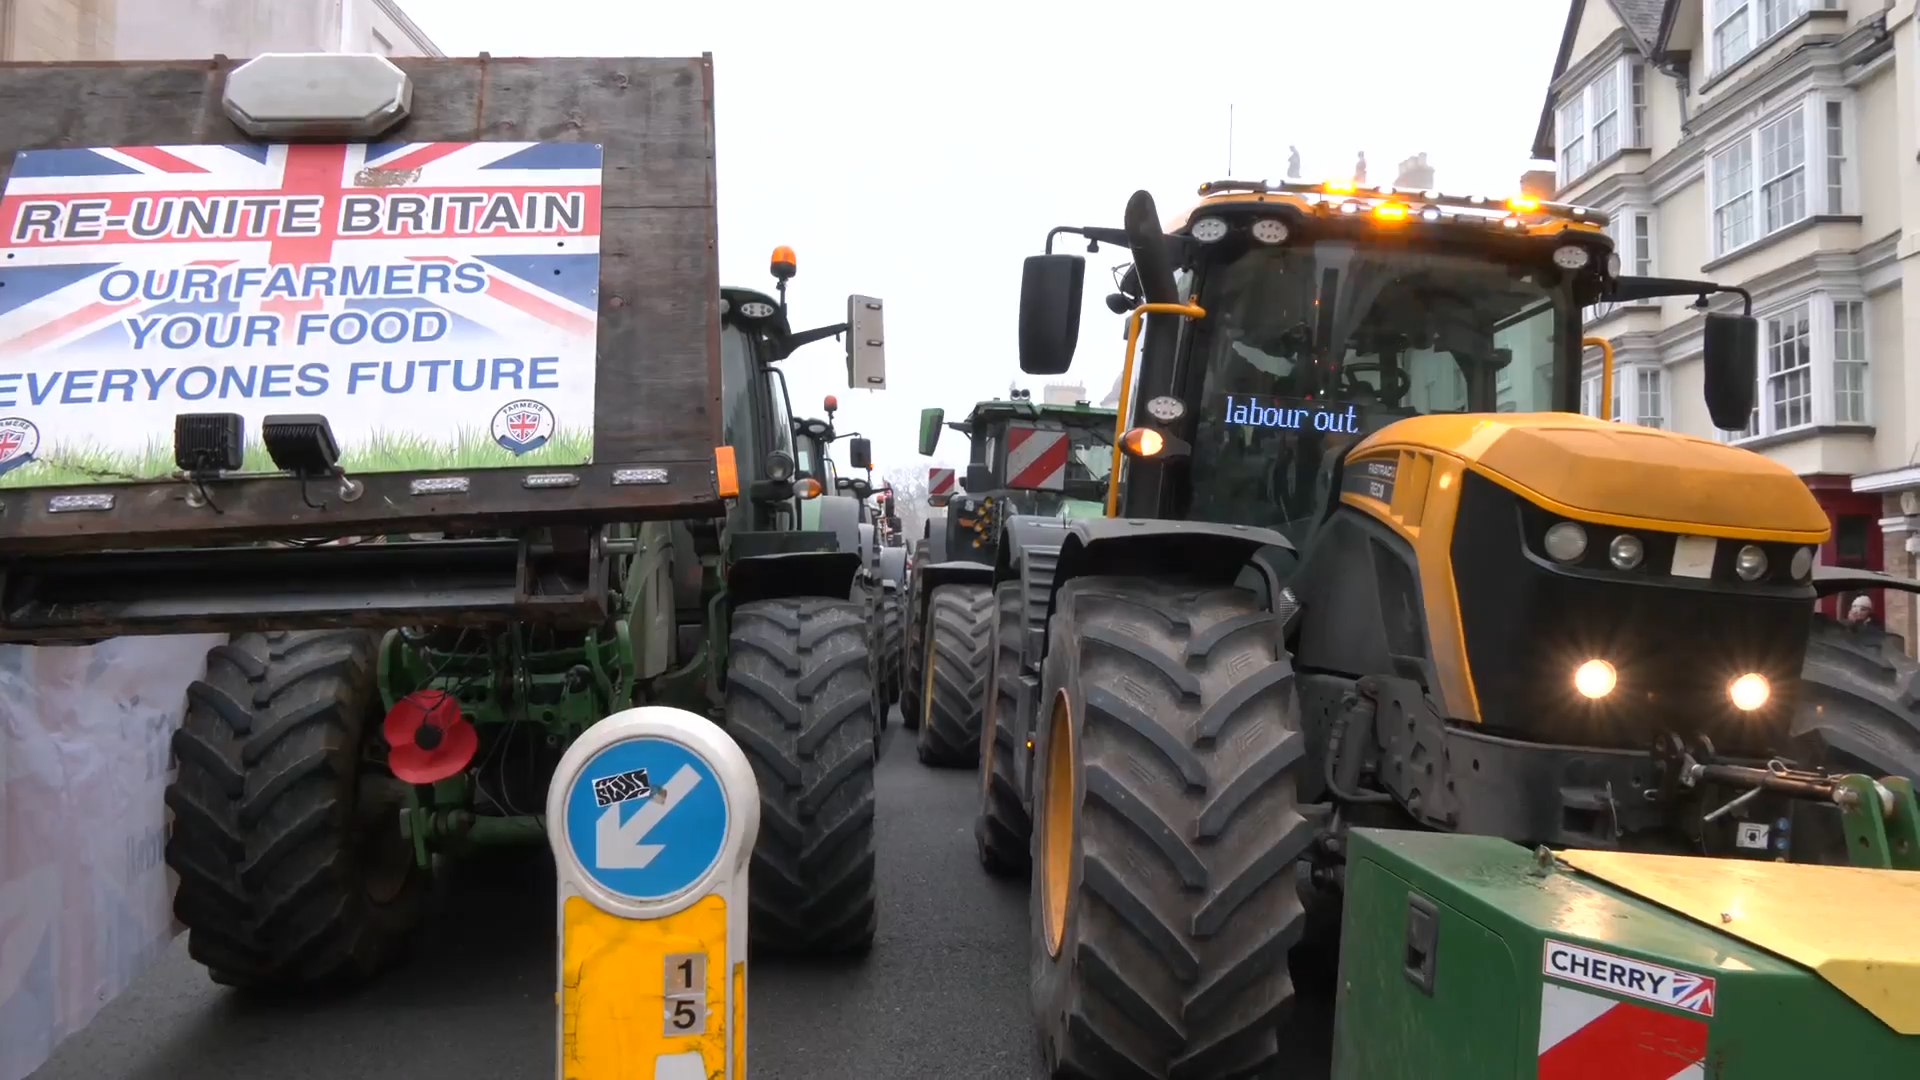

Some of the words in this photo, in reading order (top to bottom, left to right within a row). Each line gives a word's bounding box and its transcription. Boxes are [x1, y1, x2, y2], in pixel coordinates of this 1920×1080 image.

[15, 198, 321, 239] RE-UNITE
[342, 195, 581, 233] BRITAIN
[101, 267, 217, 301] OUR
[234, 263, 487, 298] FARMERS
[128, 315, 279, 350] YOUR
[298, 311, 448, 346] FOOD
[348, 357, 560, 395] FUTURE
[503, 402, 544, 414] FARMERS
[1224, 396, 1309, 428] labour
[1313, 405, 1359, 433] out
[1551, 950, 1667, 994] CHERRY
